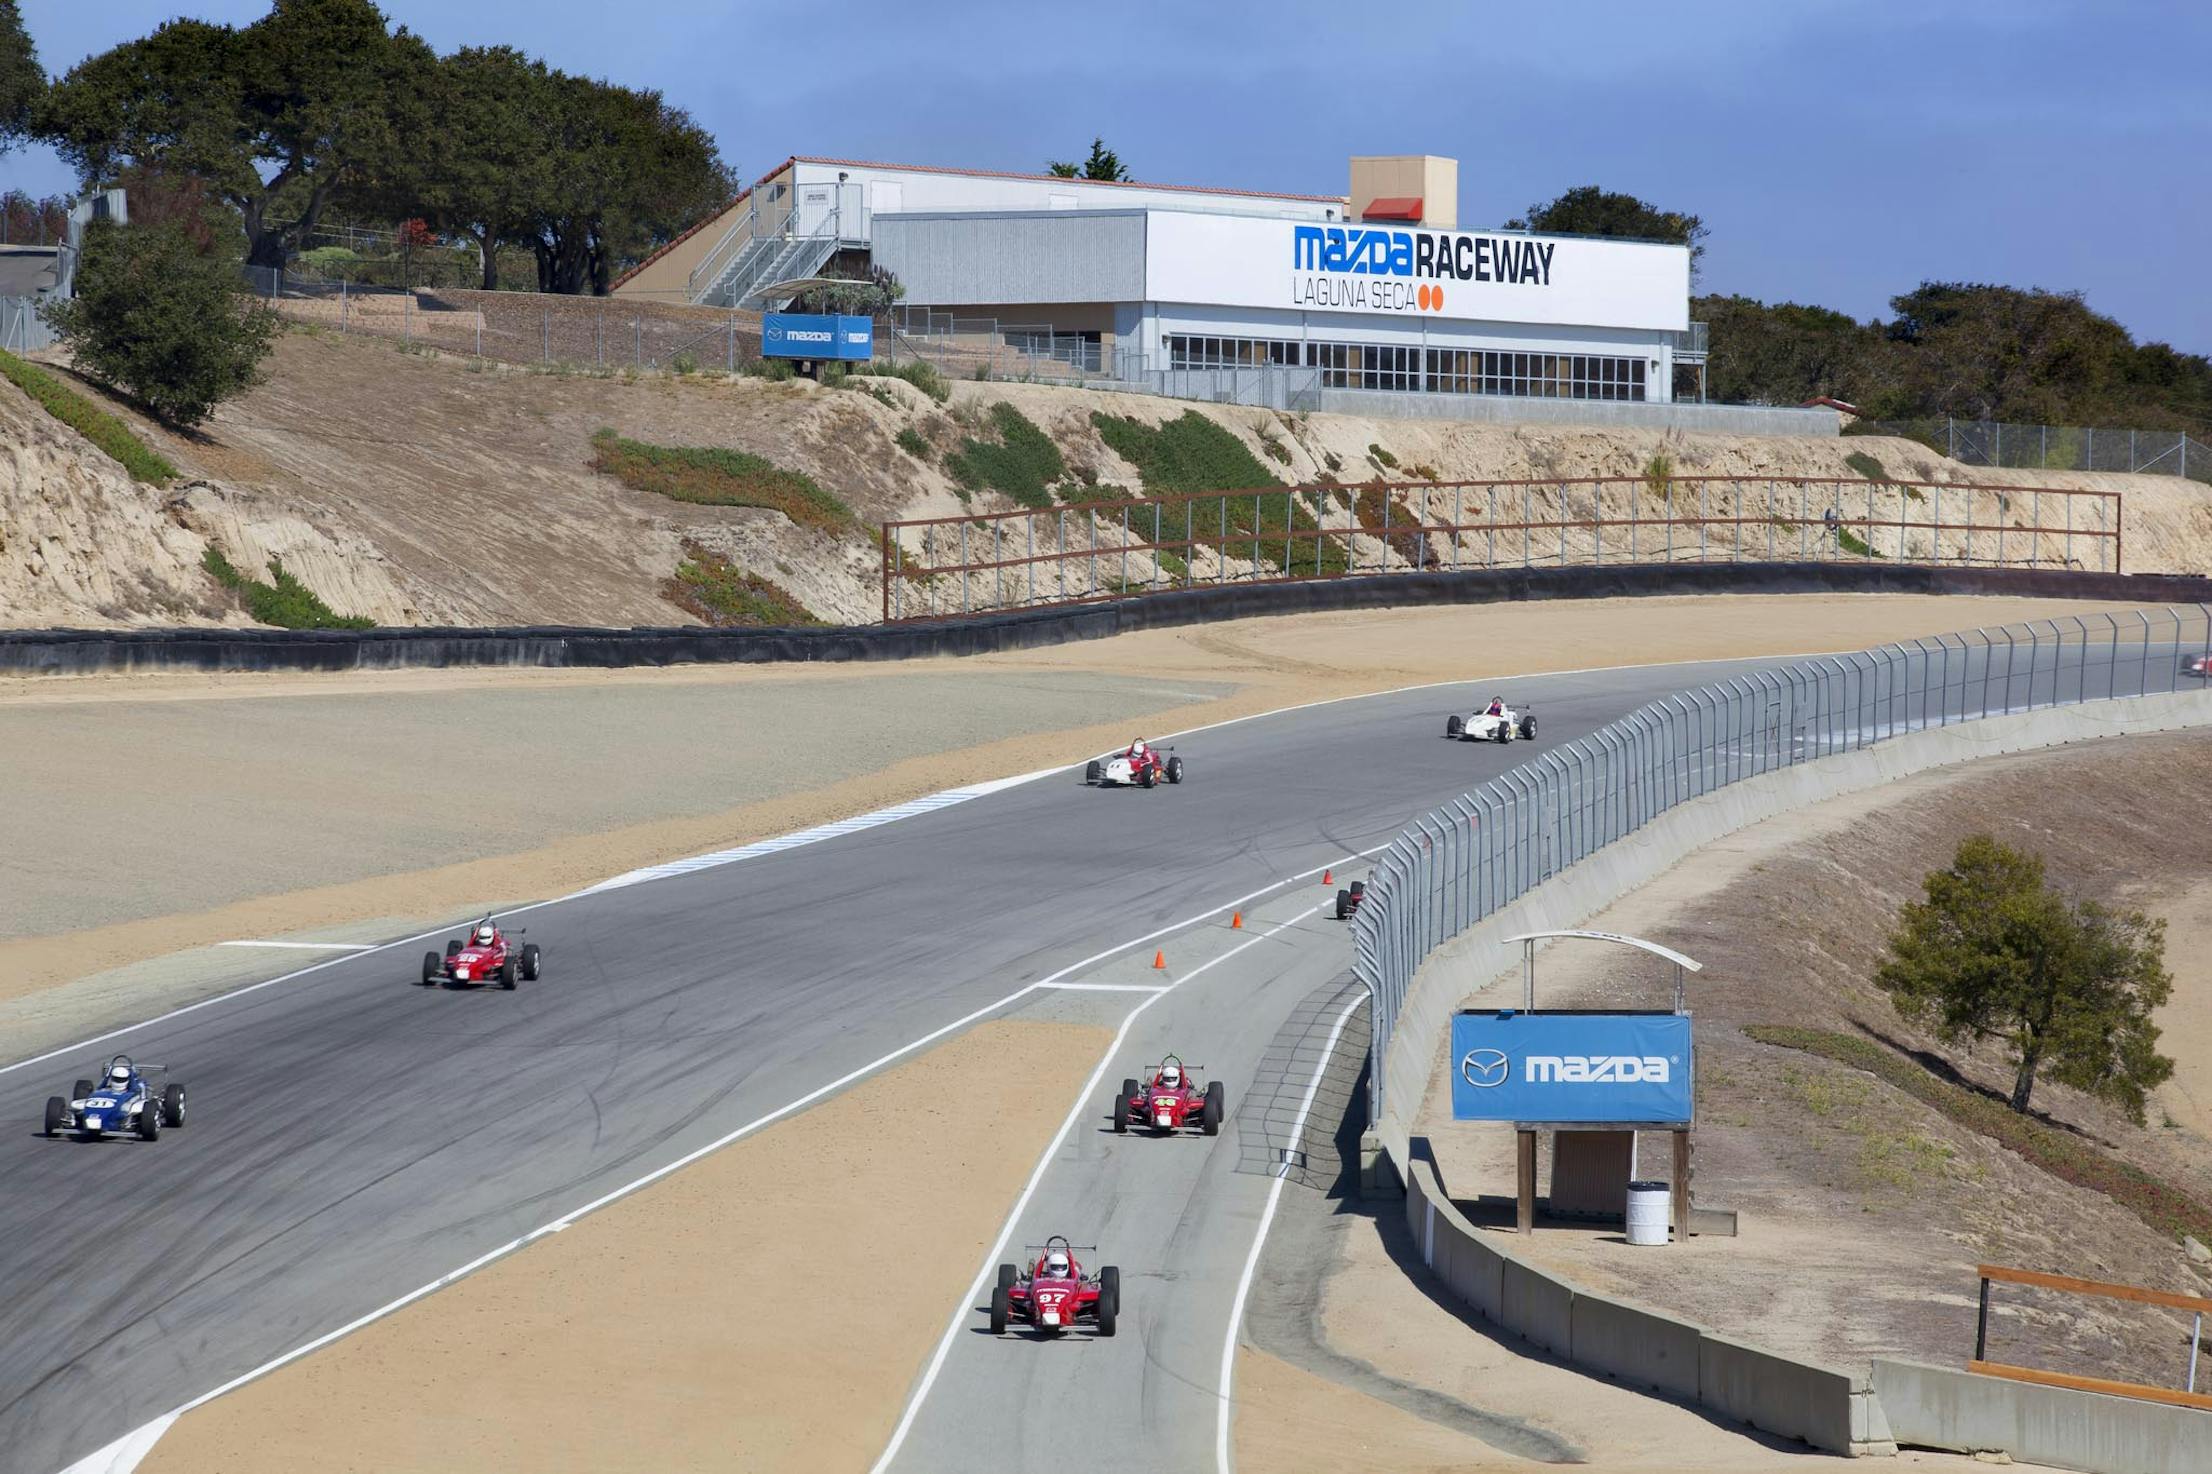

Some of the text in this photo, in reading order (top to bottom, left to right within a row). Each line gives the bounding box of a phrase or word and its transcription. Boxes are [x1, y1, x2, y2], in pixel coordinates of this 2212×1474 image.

[1416, 233, 1555, 286] RACEWAY
[1294, 277, 1417, 311] LAGUNA SECA
